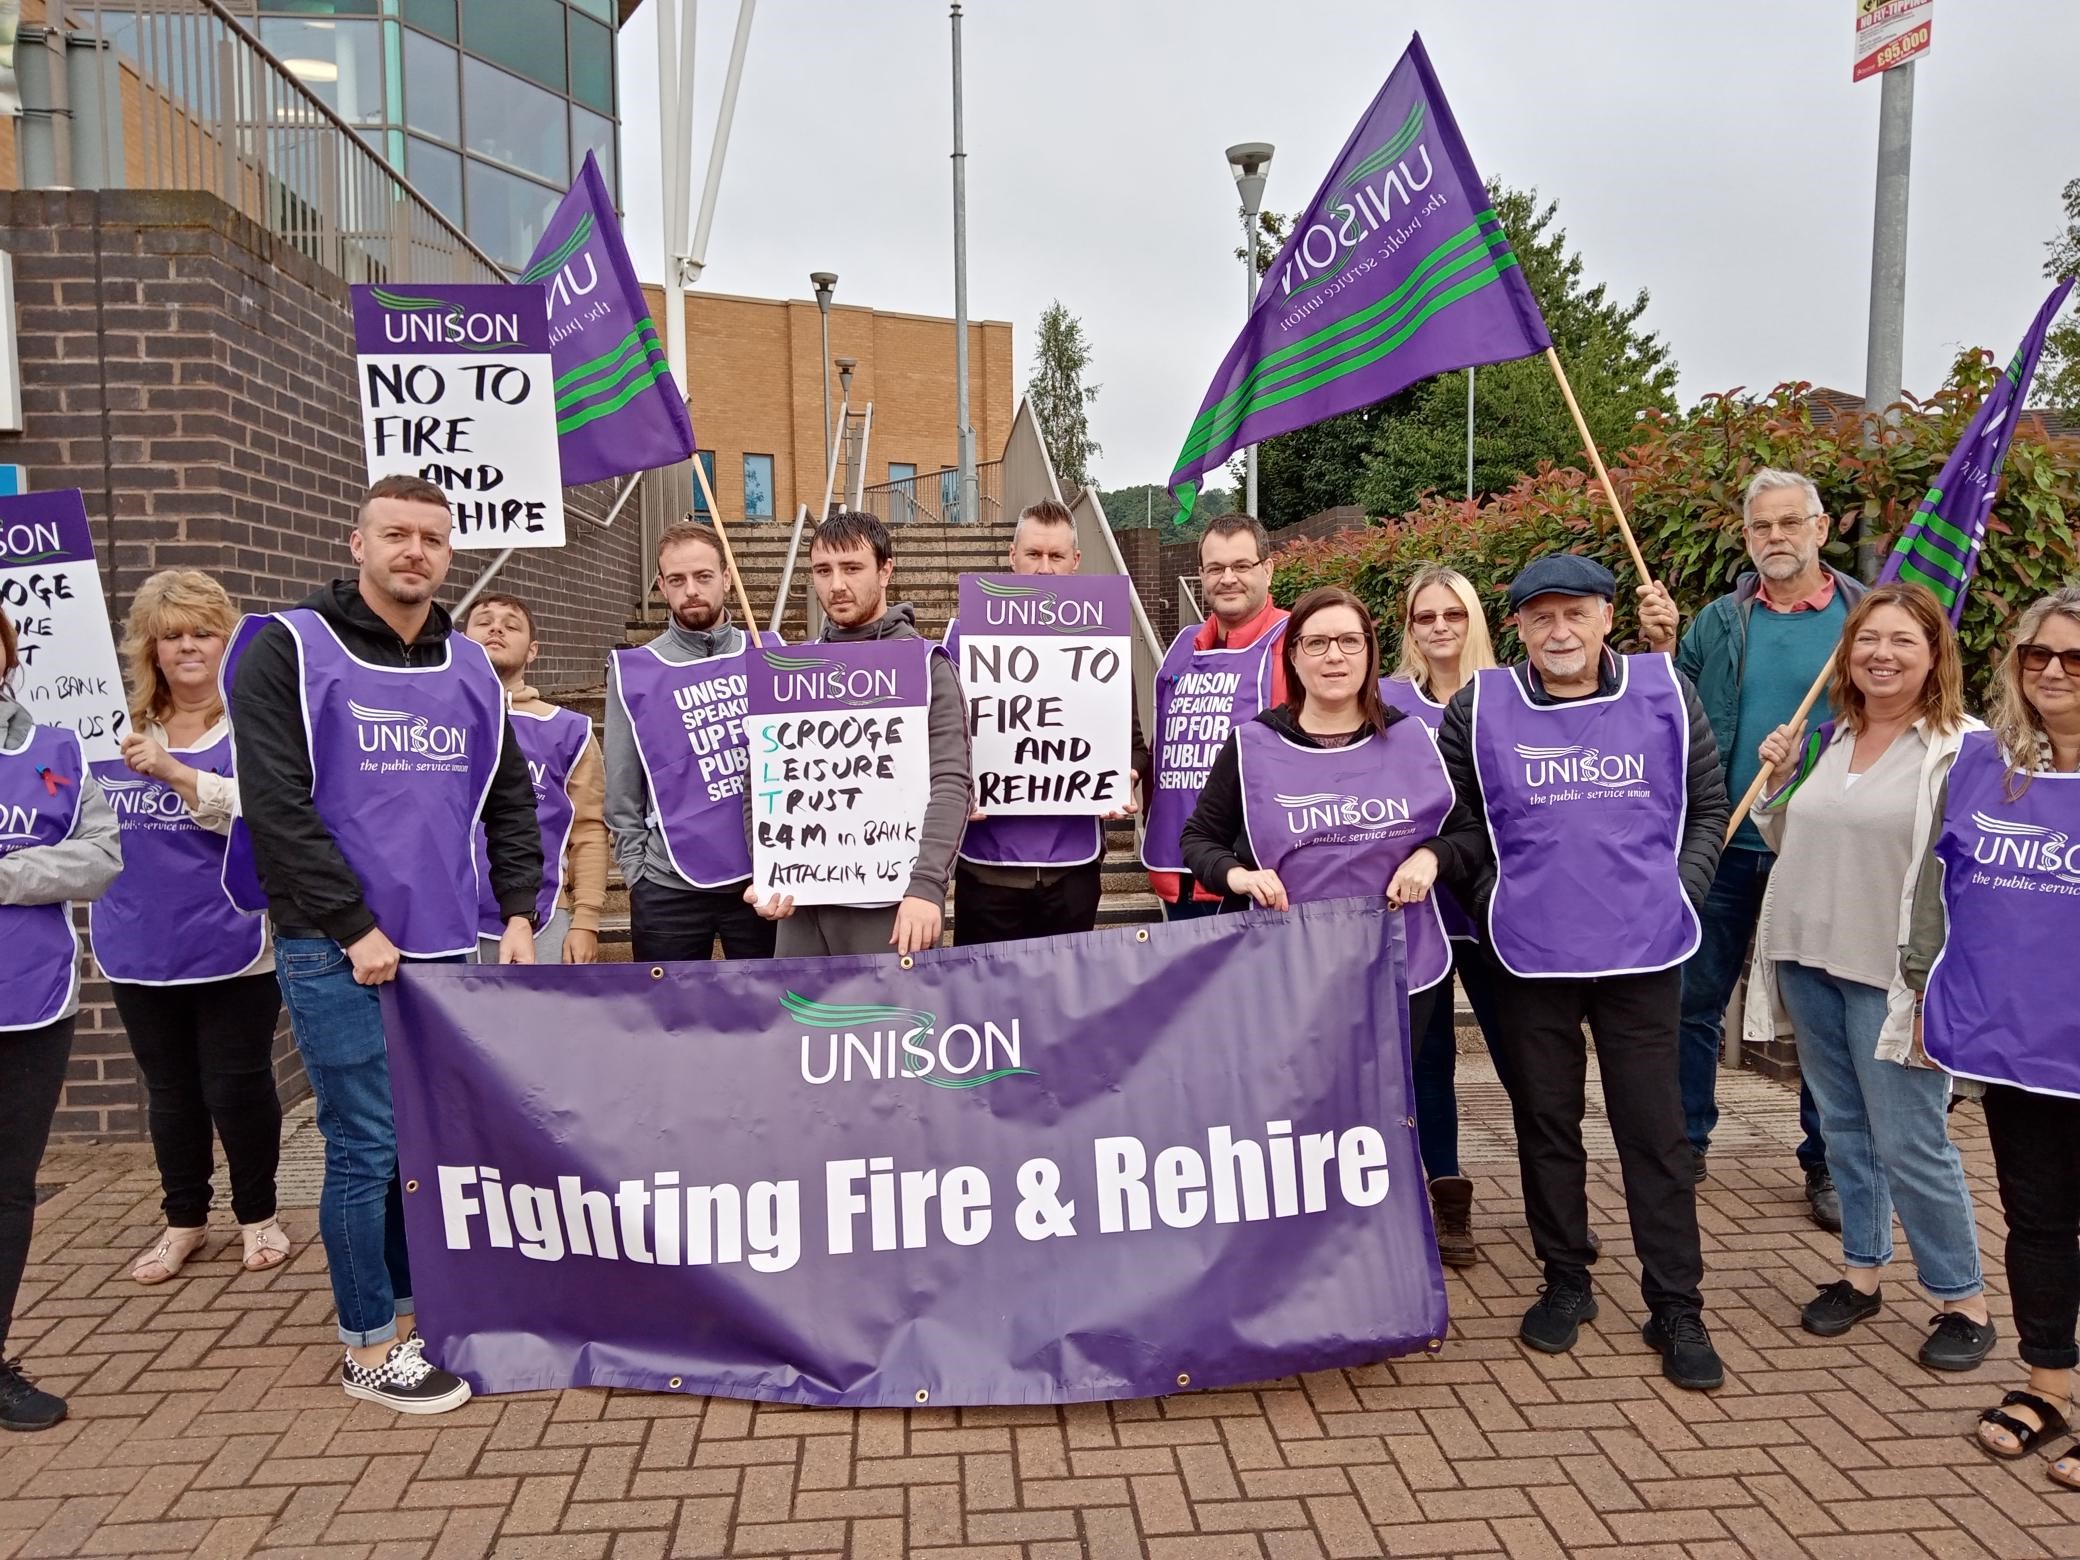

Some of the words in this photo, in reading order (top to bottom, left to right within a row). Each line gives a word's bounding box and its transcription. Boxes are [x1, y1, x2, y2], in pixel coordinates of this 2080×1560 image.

[1860, 12, 1873, 29] NO
[1877, 28, 1929, 68] £95,000
[384, 312, 519, 343] UNISON
[366, 363, 445, 408] NO
[457, 363, 531, 405] TO
[372, 415, 476, 456] FIRE
[419, 463, 504, 492] AND
[450, 498, 547, 535] HIRE
[986, 599, 1103, 626] UNISON
[968, 644, 1040, 684] NO
[1059, 645, 1120, 684] TO
[55, 676, 108, 700] BANK
[773, 668, 897, 702] UNISON
[1174, 671, 1242, 696] UNISON
[969, 694, 1065, 737] FIRE
[1168, 695, 1234, 715] SPEAKING
[358, 724, 467, 754] UNISON
[688, 724, 726, 756] UP
[762, 715, 905, 753] SCROOGE
[1164, 715, 1188, 742] UP
[1187, 715, 1231, 741] FOR
[360, 759, 378, 771] the
[415, 760, 451, 772] service
[1014, 736, 1092, 765] AND
[763, 753, 895, 784] LEISURE
[1525, 753, 1645, 787] UNISON
[759, 787, 863, 815] TRUST
[978, 769, 1120, 807] REHIRE
[1530, 793, 1547, 806] the
[1586, 788, 1625, 800] service
[1627, 787, 1650, 799] union
[143, 821, 177, 832] service
[1288, 798, 1410, 834] UNISON
[838, 832, 856, 846] in
[863, 820, 917, 846] BANK
[1313, 832, 1347, 846] public
[1349, 829, 1387, 842] service
[1388, 826, 1417, 838] union
[1973, 836, 2080, 874] UNISO
[768, 861, 867, 888] ATTACKING
[1972, 871, 1990, 885] the
[1992, 875, 2037, 890] public
[2039, 883, 2080, 896] servic
[800, 1018, 1021, 1086] UNISON
[436, 1164, 801, 1274] Fighting
[825, 1156, 993, 1255] Fire
[1014, 1156, 1078, 1242] &
[1094, 1119, 1391, 1234] Rehire
